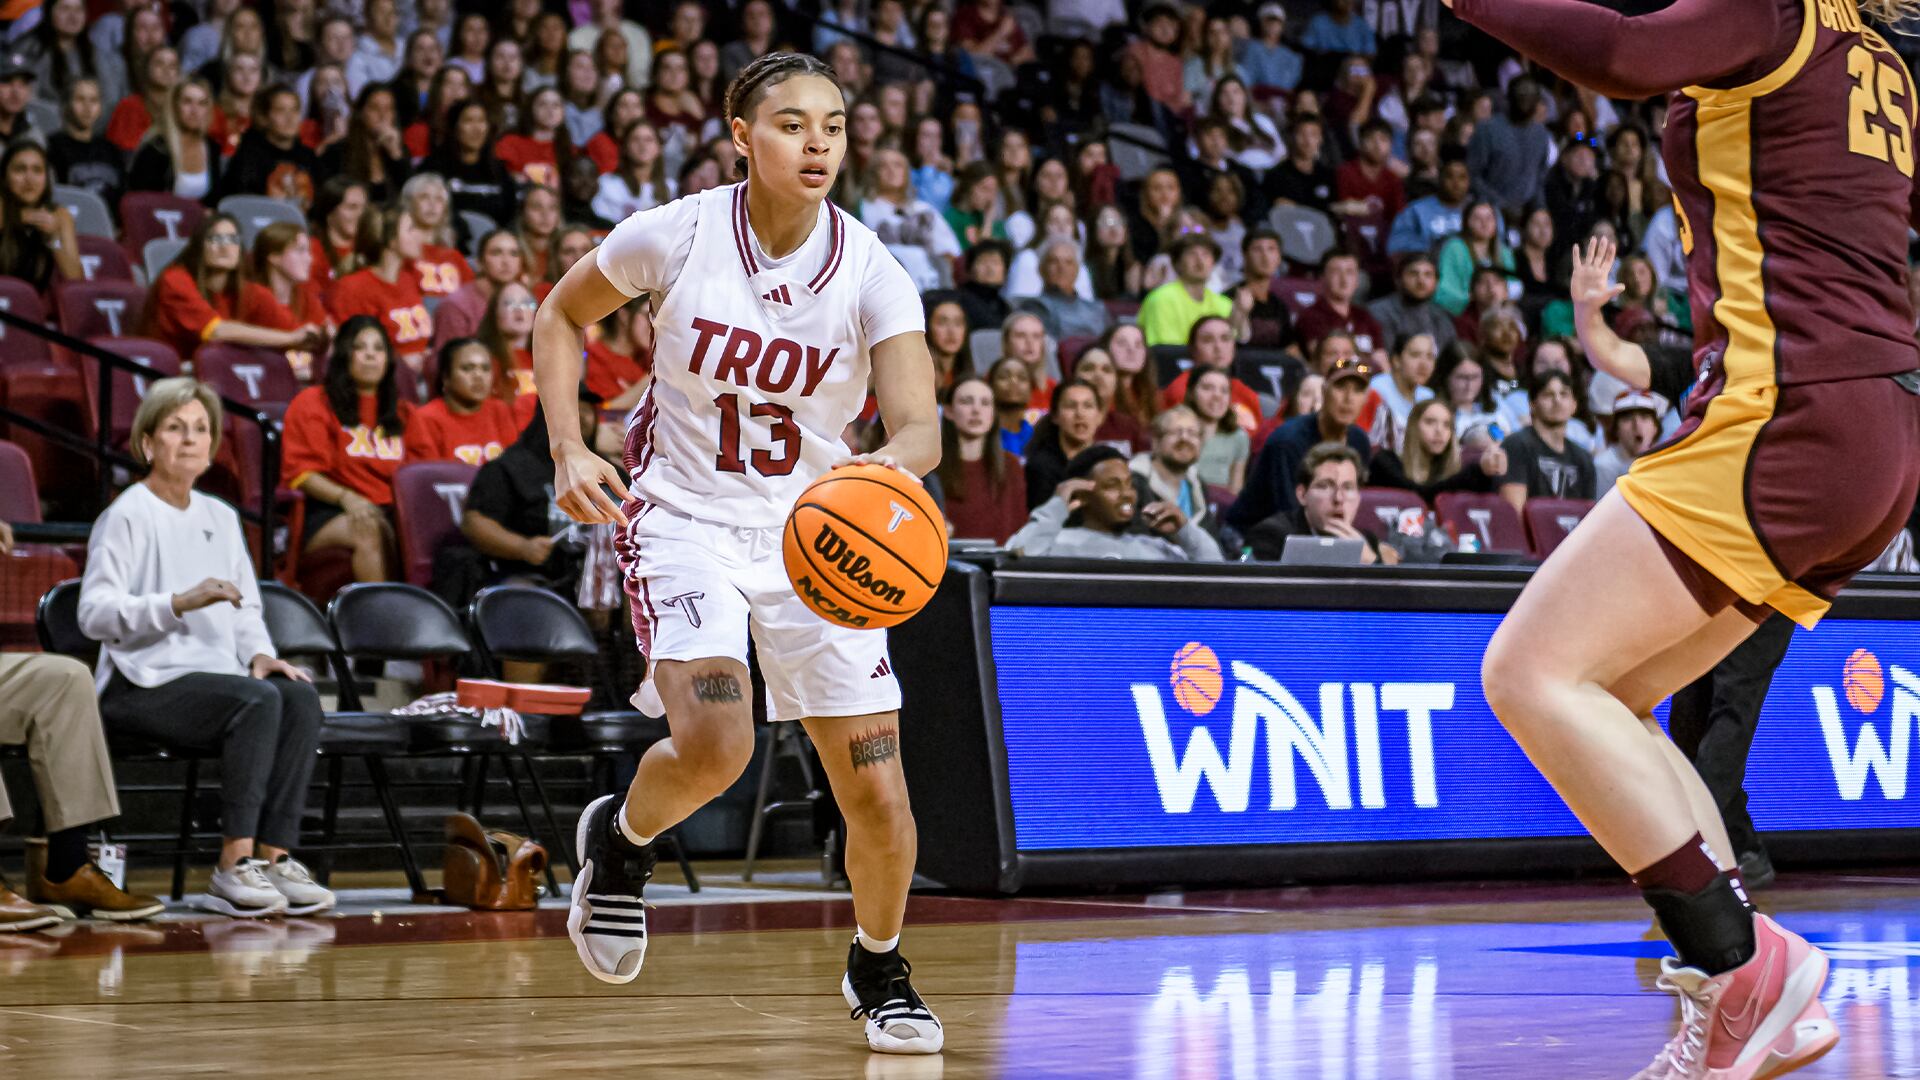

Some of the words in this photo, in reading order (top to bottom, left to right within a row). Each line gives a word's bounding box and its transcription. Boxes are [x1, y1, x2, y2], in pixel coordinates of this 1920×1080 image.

[1846, 44, 1915, 179] 25
[687, 316, 841, 397] TROY
[713, 393, 802, 477] 13
[797, 575, 870, 627] NCAA
[814, 523, 906, 606] Wilson
[696, 677, 739, 698] RARE
[852, 734, 895, 763] BREED
[1130, 660, 1456, 814] WNIT
